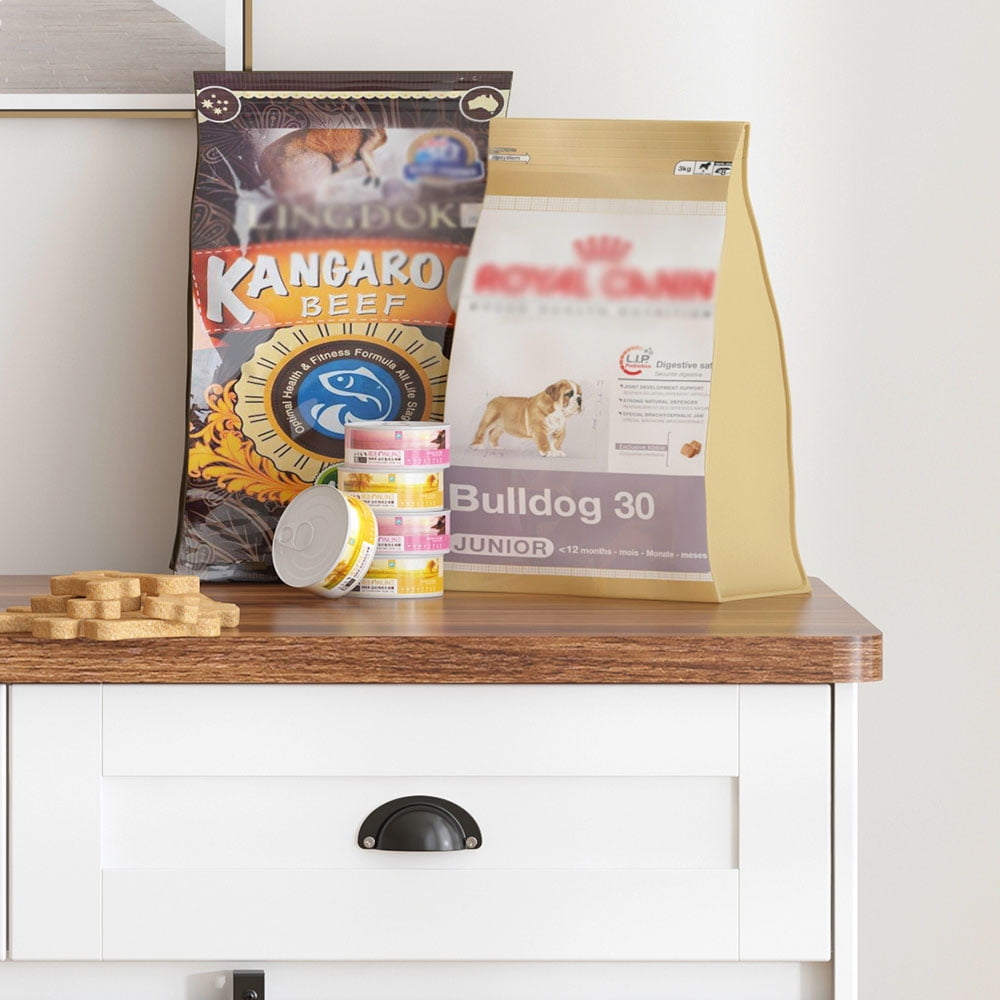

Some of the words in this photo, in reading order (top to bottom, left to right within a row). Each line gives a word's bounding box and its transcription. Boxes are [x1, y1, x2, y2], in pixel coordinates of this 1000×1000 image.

[301, 293, 407, 318] BEEF
[310, 348, 351, 365] Fitness
[354, 348, 397, 370] Formula
[656, 361, 698, 370] Digestive
[300, 362, 311, 371] &
[395, 369, 410, 382] All
[282, 370, 303, 399] Health
[404, 381, 416, 399] Life
[282, 401, 305, 435] Optimal
[450, 483, 602, 525] Bulldog
[614, 491, 655, 520] 30
[453, 536, 547, 556] JUNIOR
[580, 547, 612, 556] months
[619, 548, 640, 557] mois
[646, 550, 675, 559] Monate
[681, 552, 708, 560] meses
